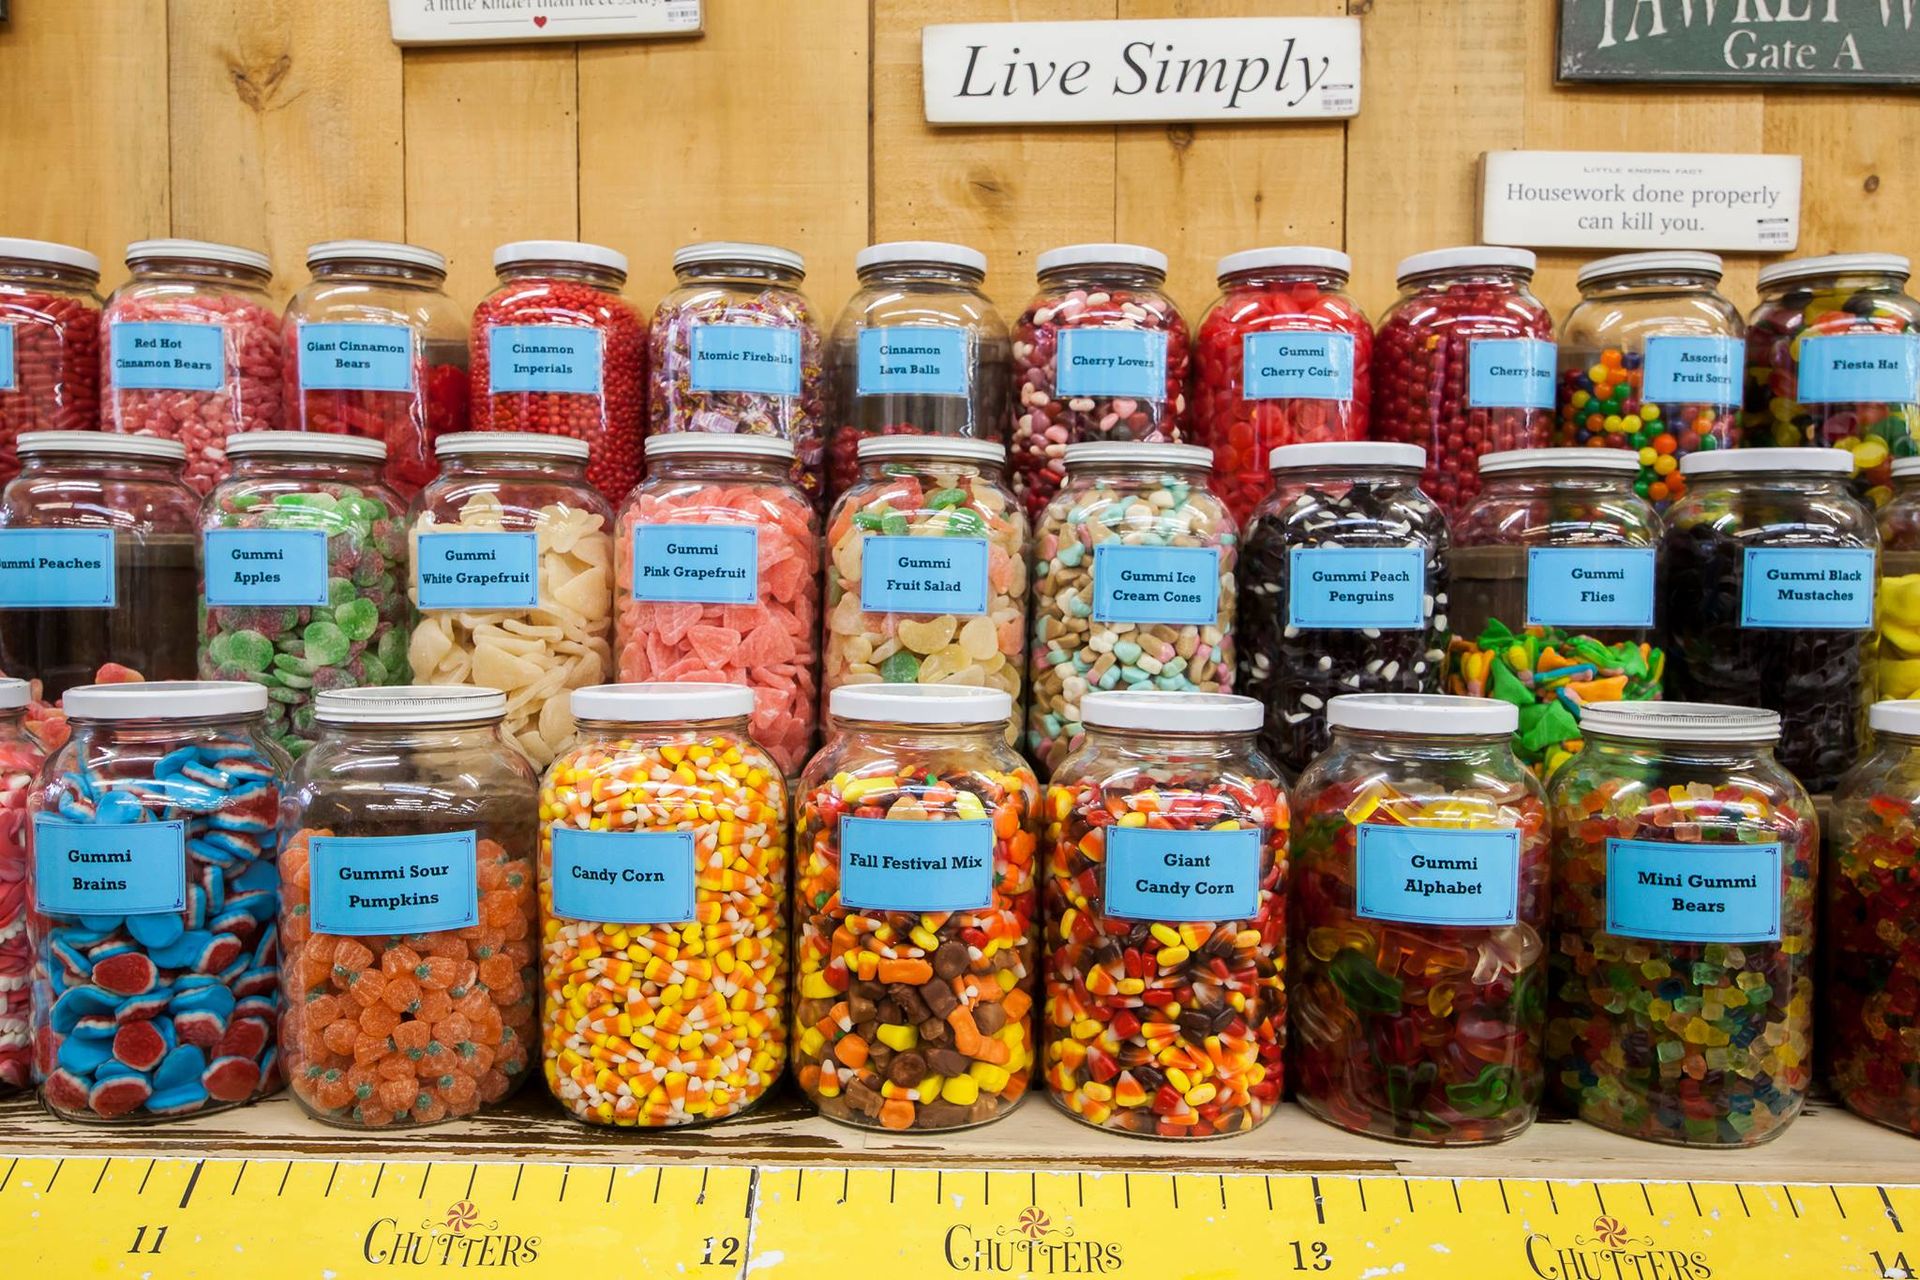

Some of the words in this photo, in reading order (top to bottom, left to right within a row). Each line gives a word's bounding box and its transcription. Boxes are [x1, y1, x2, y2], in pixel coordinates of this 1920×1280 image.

[1723, 29, 1817, 70] Gate
[1833, 33, 1864, 70] A
[953, 45, 1091, 98] Live
[1112, 37, 1330, 109] Simply
[1506, 183, 1625, 202] Housework
[1632, 184, 1684, 204] done
[1692, 185, 1780, 209] properly
[1578, 215, 1613, 230] can
[1622, 212, 1653, 231] kill
[1660, 216, 1704, 235] you.
[135, 338, 157, 349] Red
[160, 338, 182, 349] Hot
[306, 341, 336, 352] Giant
[339, 341, 405, 353] Cinnamon
[512, 343, 574, 354] Cinnamon
[879, 345, 941, 355] Cinnamon
[697, 350, 739, 362] Atomic
[742, 351, 793, 365] Fireballs
[1278, 347, 1325, 357] Gummi
[1680, 352, 1728, 364] Assorted
[116, 358, 170, 369] Cinnamon
[174, 358, 212, 370] Bears
[335, 358, 371, 369] Bears
[1072, 355, 1114, 368] Cherry
[1118, 356, 1154, 368] Lovers
[1832, 359, 1874, 370] Fiesta
[1877, 359, 1899, 370] Hat
[513, 364, 573, 375] Imperials
[879, 365, 907, 375] Lava
[909, 365, 941, 375] Balls
[1261, 366, 1305, 379] Cherry
[1308, 366, 1339, 377] Coins
[1490, 366, 1529, 378] Cherry
[1672, 372, 1704, 383] Fruit
[231, 548, 283, 560] Gummi
[445, 550, 496, 562] Gummi
[666, 543, 719, 556] Gummi
[0, 558, 35, 569] ummi
[38, 558, 101, 569] Peaches
[898, 556, 952, 569] Gummi
[233, 571, 281, 584] Apples
[422, 573, 453, 585] White
[456, 571, 530, 586] Grapefruit
[643, 566, 670, 578] Pink
[673, 566, 747, 581] Grapefruit
[1120, 570, 1174, 583] Gummi
[1177, 571, 1196, 583] Ice
[1312, 571, 1367, 583] Gummi
[1370, 570, 1410, 583] Peach
[1570, 567, 1625, 580] Gummi
[1766, 569, 1825, 581] Gummi
[1828, 569, 1862, 582] Black
[886, 579, 921, 591] Fruit
[924, 579, 962, 592] Salad
[1112, 589, 1159, 602] Cream
[1163, 591, 1202, 603] Cones
[1328, 590, 1395, 605] Penguins
[1580, 591, 1615, 603] Flies
[1777, 589, 1854, 601] Mustaches
[67, 848, 133, 864] Gummi
[849, 853, 879, 868] Fall
[882, 854, 947, 871] Festival
[951, 854, 983, 869] Mix
[1163, 853, 1211, 868] Giant
[1410, 855, 1478, 871] Gummi
[338, 865, 405, 881] Gummi
[409, 862, 449, 879] Sour
[571, 865, 618, 887] Candy
[622, 868, 665, 883] Corn
[72, 876, 127, 891] Brains
[1637, 870, 1682, 888] Mini
[1687, 874, 1757, 889] Gummi
[1135, 879, 1191, 897] Candy
[1194, 880, 1235, 895] Corn
[1404, 879, 1483, 898] Alphabet
[348, 891, 440, 910] Pumpkins
[1671, 898, 1726, 914] Bears
[126, 1225, 170, 1255] 11
[363, 1217, 543, 1268] CHUTTERS
[700, 1235, 740, 1269] 12
[943, 1223, 1124, 1275] CHUTTERS
[1288, 1240, 1333, 1272] 13
[1524, 1232, 1712, 1280] CHUTTERS
[1869, 1250, 1918, 1280] 14
